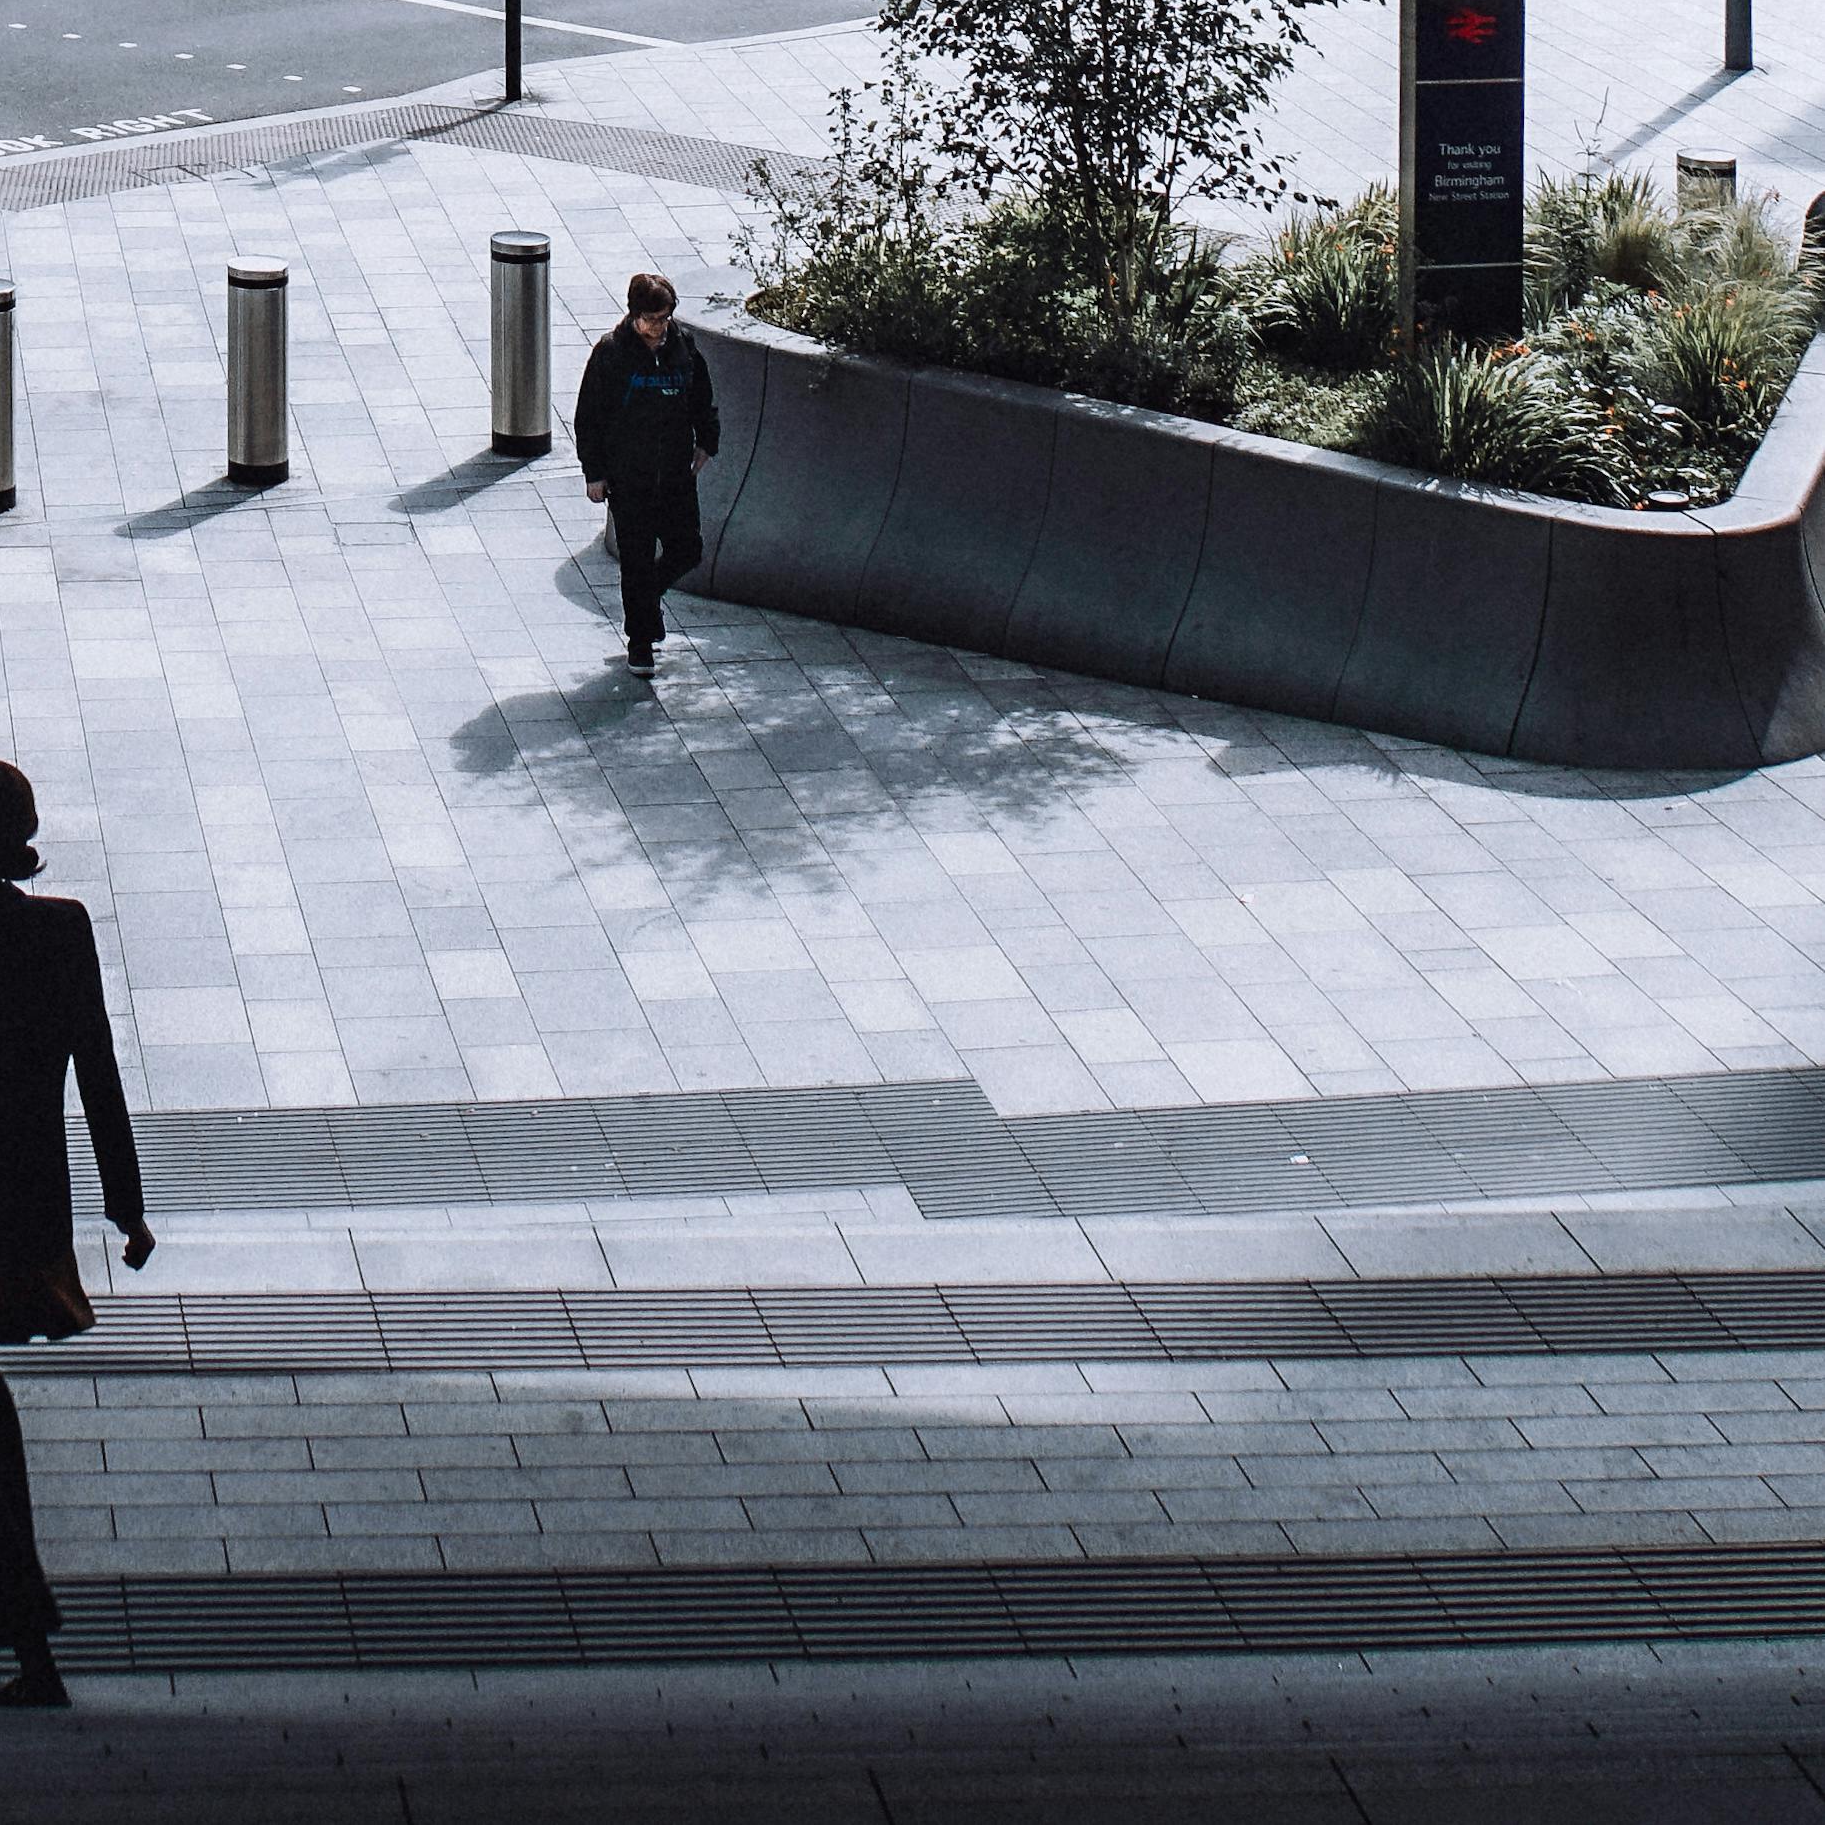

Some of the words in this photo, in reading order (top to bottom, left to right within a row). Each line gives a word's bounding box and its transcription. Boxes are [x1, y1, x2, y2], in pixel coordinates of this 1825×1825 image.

[70, 108, 213, 140] RIGHT
[1438, 143, 1475, 156] Thank
[1478, 145, 1501, 158] you
[1435, 175, 1505, 188] Birmingham
